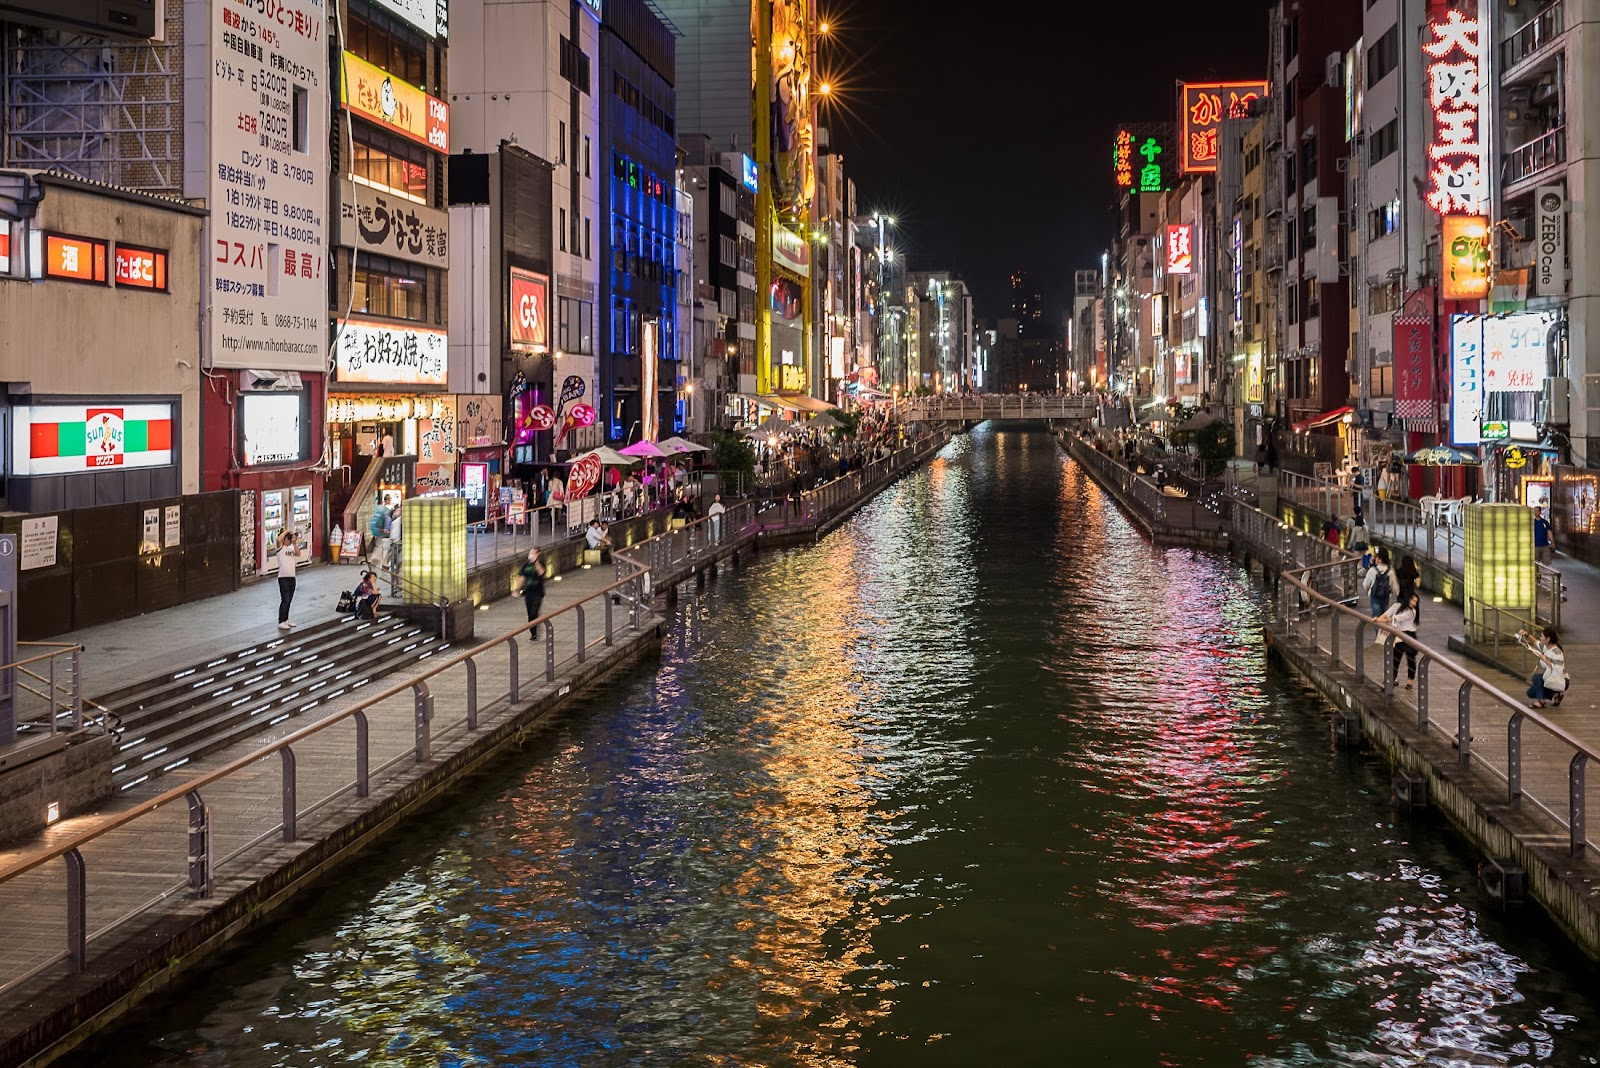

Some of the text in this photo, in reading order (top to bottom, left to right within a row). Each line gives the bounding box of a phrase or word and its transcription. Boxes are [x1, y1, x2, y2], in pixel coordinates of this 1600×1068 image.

[223, 30, 263, 63] 中国自動車道
[260, 69, 287, 96] 5,200円
[237, 110, 287, 138] 土日祝 7,800円
[430, 99, 446, 123] 17:00
[1422, 9, 1479, 216] 大阪王将
[242, 150, 313, 185] ロッジ 1泊 3,780円
[1117, 130, 1132, 186] お好み焼
[1140, 138, 1162, 186] 千房
[264, 197, 278, 215] 平日
[358, 196, 424, 255] うなぎ
[1542, 215, 1555, 255] ZERO
[62, 245, 78, 273] 酒
[116, 255, 153, 282] たばこ
[216, 239, 263, 270] コスパ
[215, 277, 265, 298] 幹部スタッフ募集
[222, 307, 253, 326] 予約受付
[275, 314, 317, 330] 0868-75-1144
[519, 293, 537, 329] G3
[222, 333, 319, 354] http://www.nihonbaracc.com
[364, 331, 417, 367] お好み焼
[1409, 326, 1422, 390] 大阪みやげ
[1507, 369, 1534, 386] 免税
[563, 389, 582, 402] BAR
[531, 406, 555, 428] G3
[572, 406, 594, 424] G3
